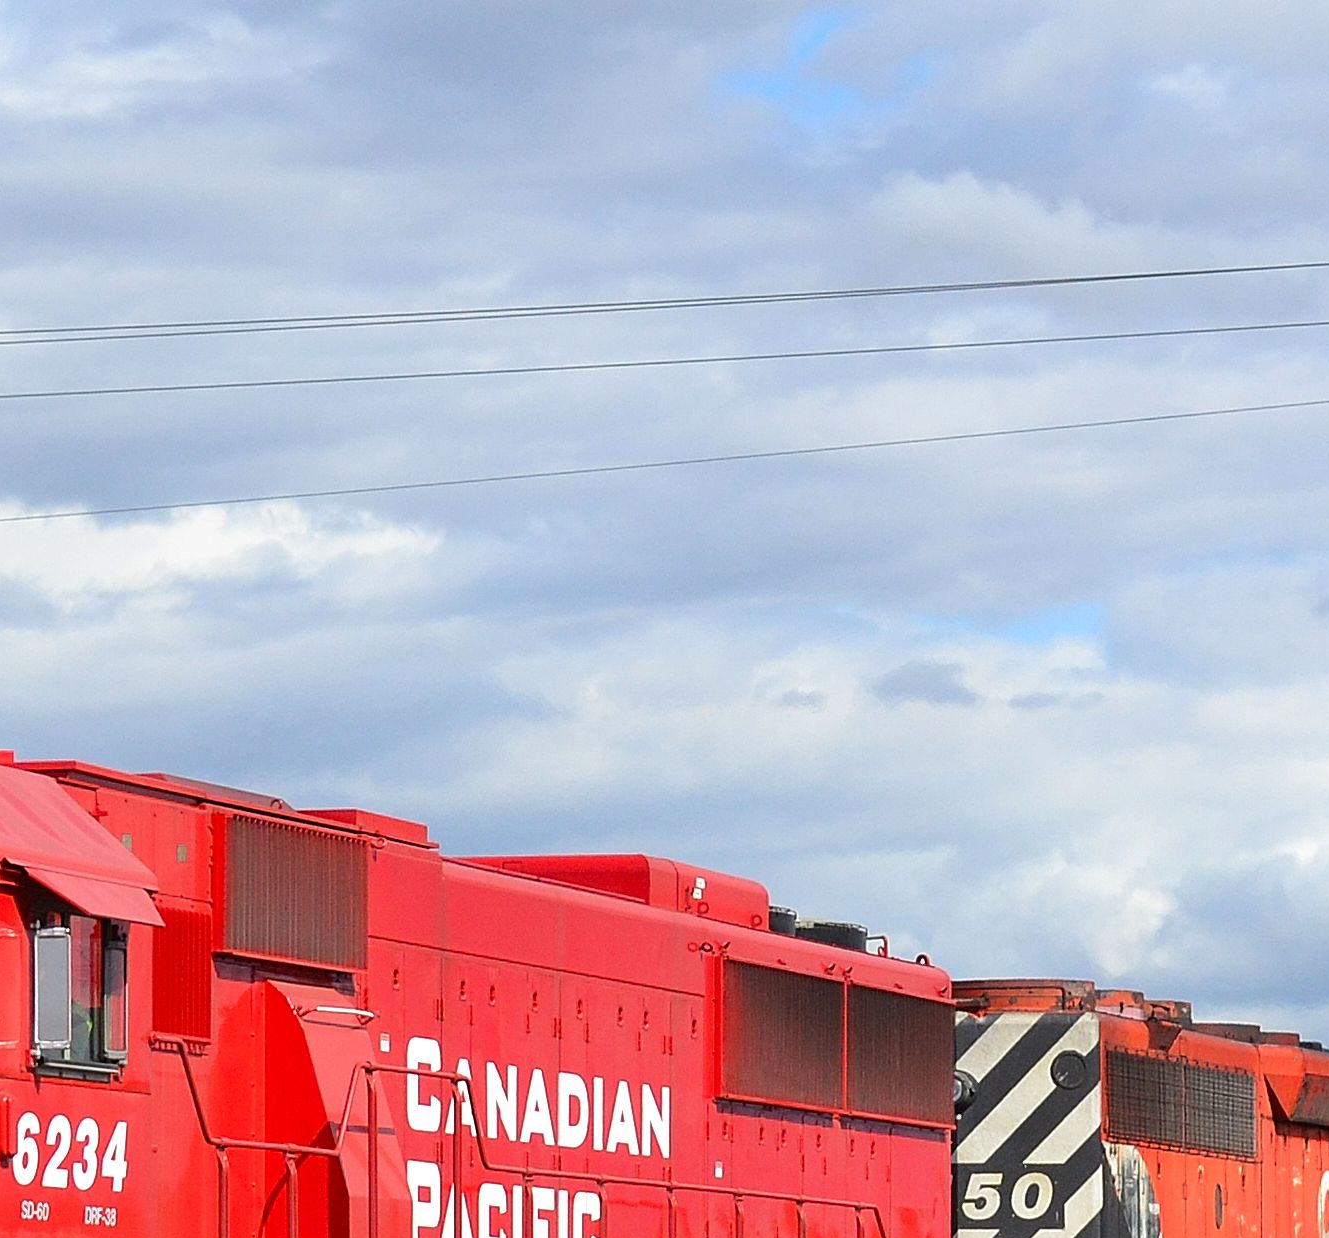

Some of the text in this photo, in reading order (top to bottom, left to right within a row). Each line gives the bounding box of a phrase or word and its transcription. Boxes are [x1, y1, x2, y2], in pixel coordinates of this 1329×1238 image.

[406, 1036, 670, 1159] CANADIAN
[12, 1111, 128, 1193] 6234
[21, 1200, 49, 1221] SD-60
